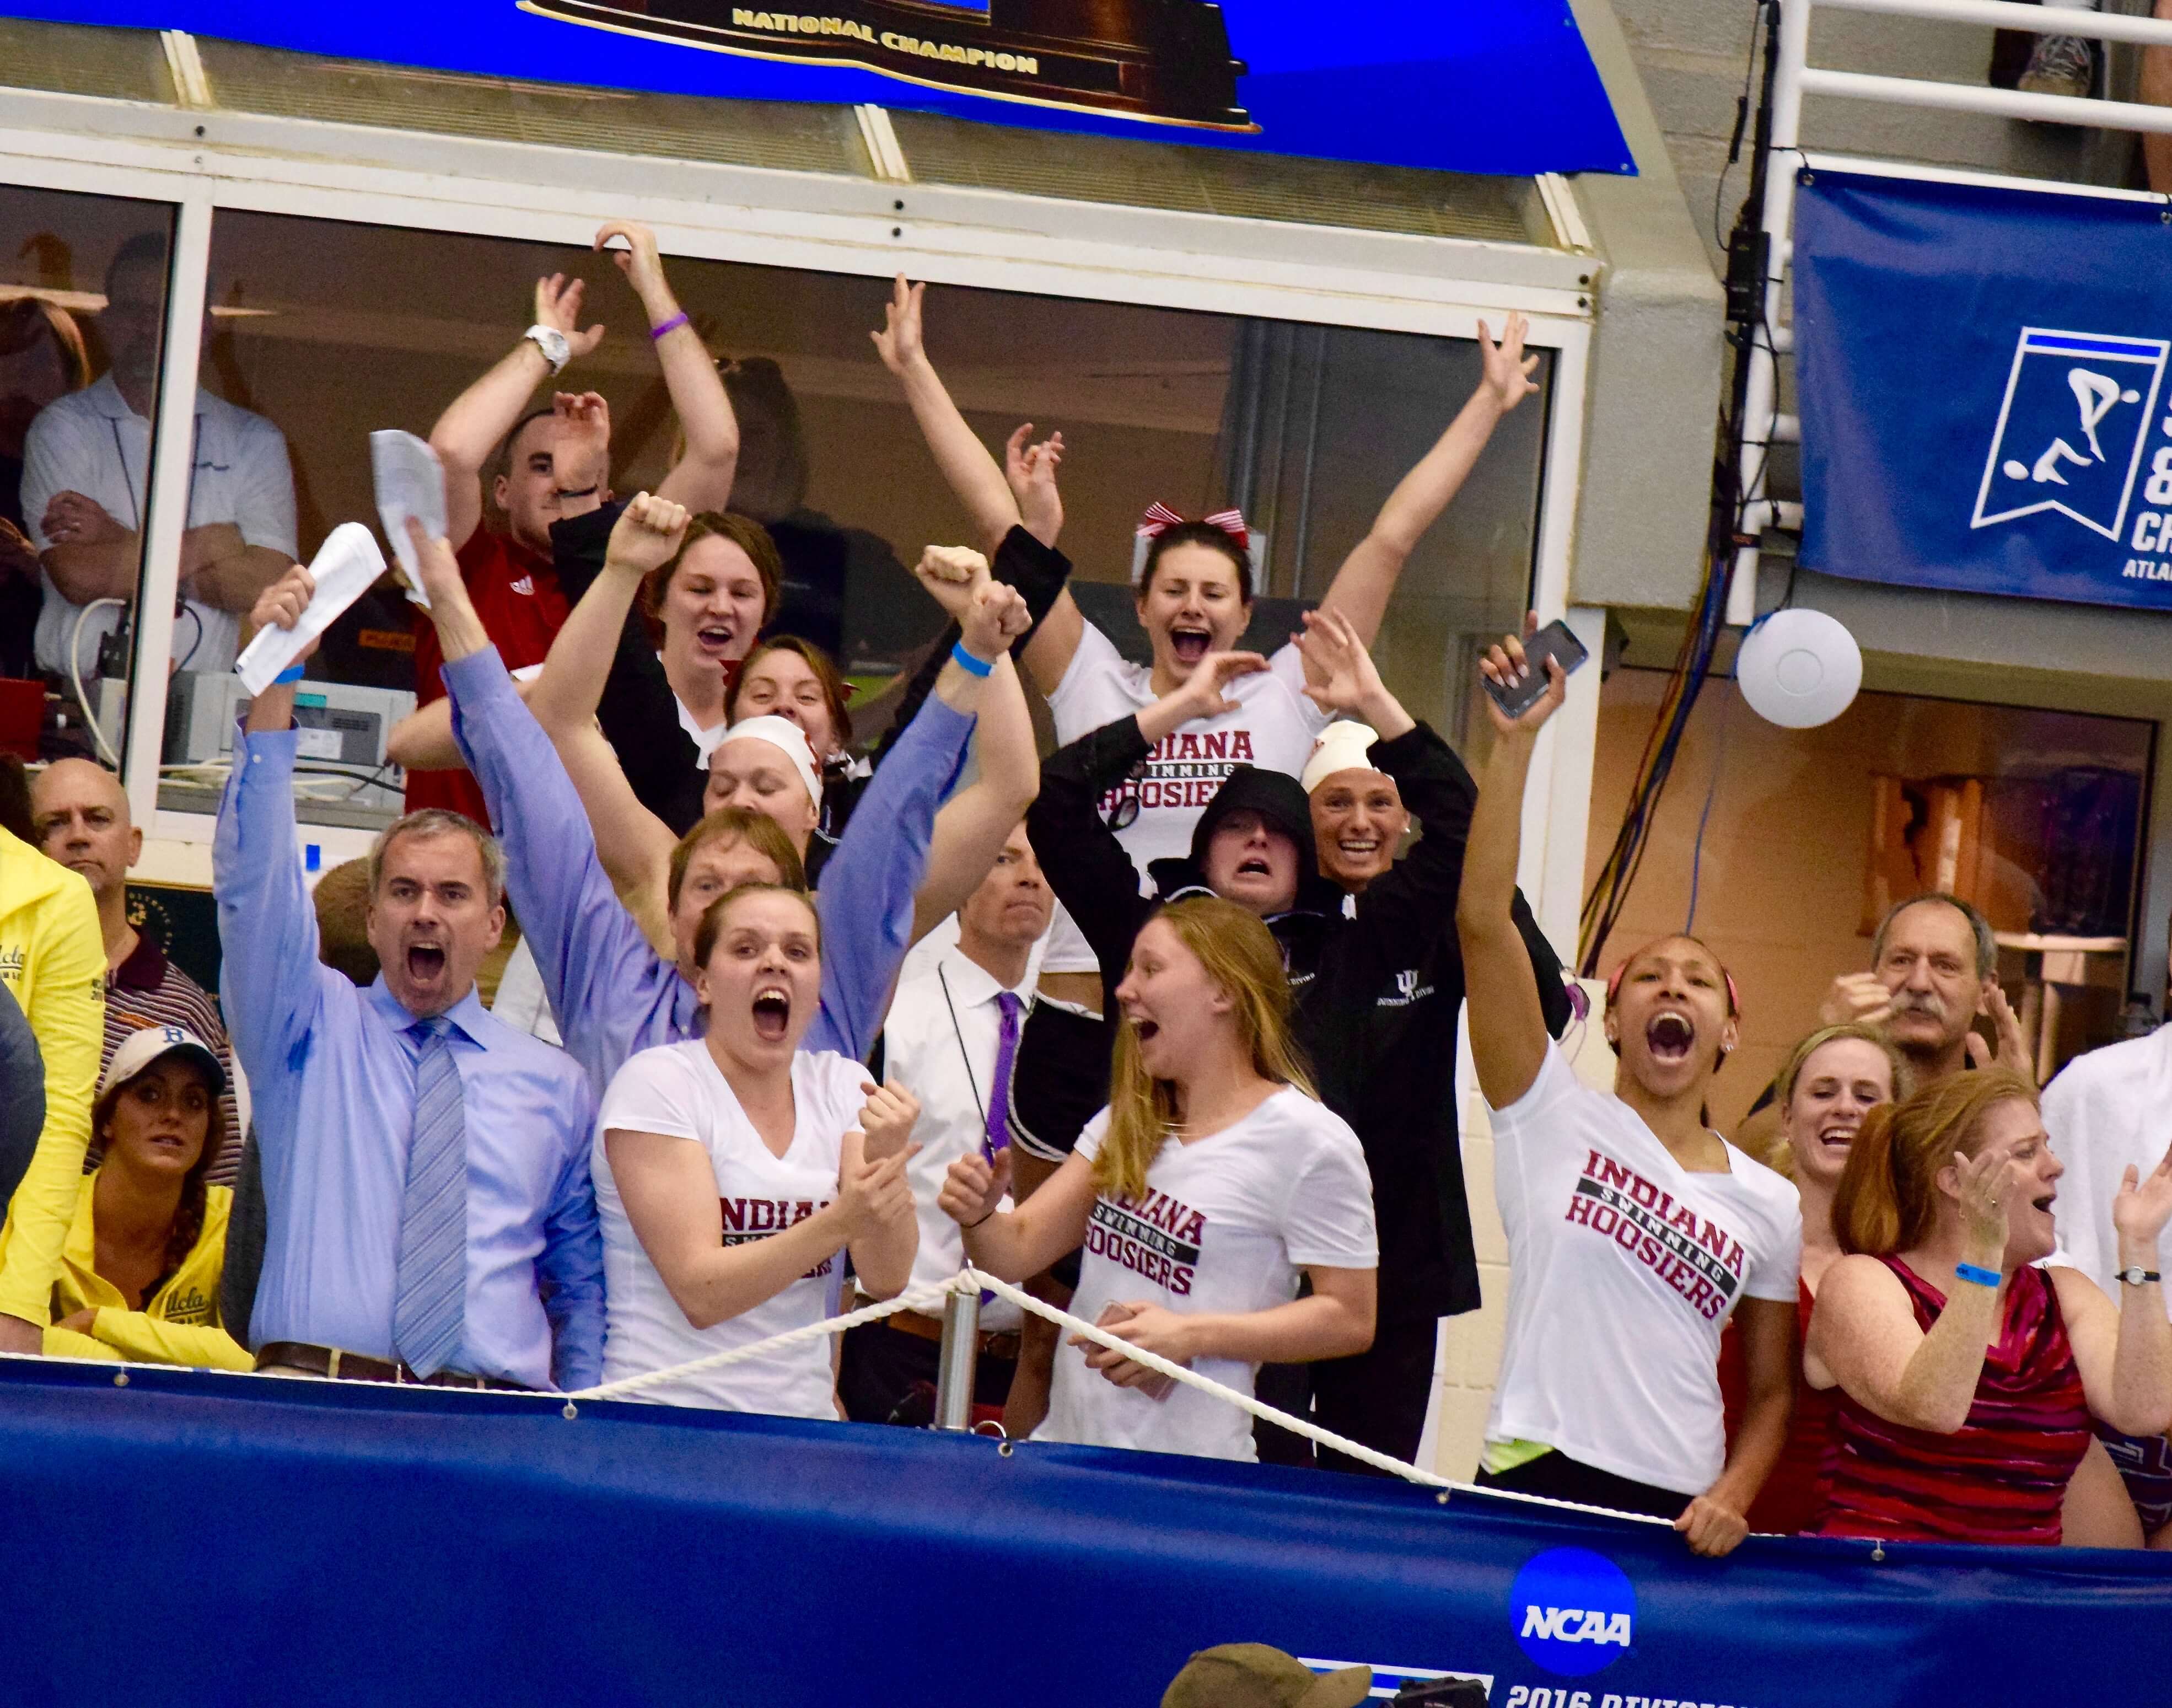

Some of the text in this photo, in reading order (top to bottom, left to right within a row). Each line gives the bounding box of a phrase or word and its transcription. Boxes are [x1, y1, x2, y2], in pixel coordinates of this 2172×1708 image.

[732, 8, 1038, 74] NATIONAL CHAMPION
[2122, 559, 2172, 581] ATLA
[1150, 763, 1235, 777] IMMING
[163, 1026, 184, 1043] B
[719, 1197, 829, 1231] NDIA
[1094, 1204, 1176, 1257] SWIMMING
[1583, 1149, 1745, 1279] INDIANA
[1600, 1189, 1724, 1282] SWIMMING
[1086, 1224, 1195, 1296] OOSIERS
[1565, 1195, 1727, 1320] HOOSIERS
[1520, 1605, 1631, 1647] NCAA
